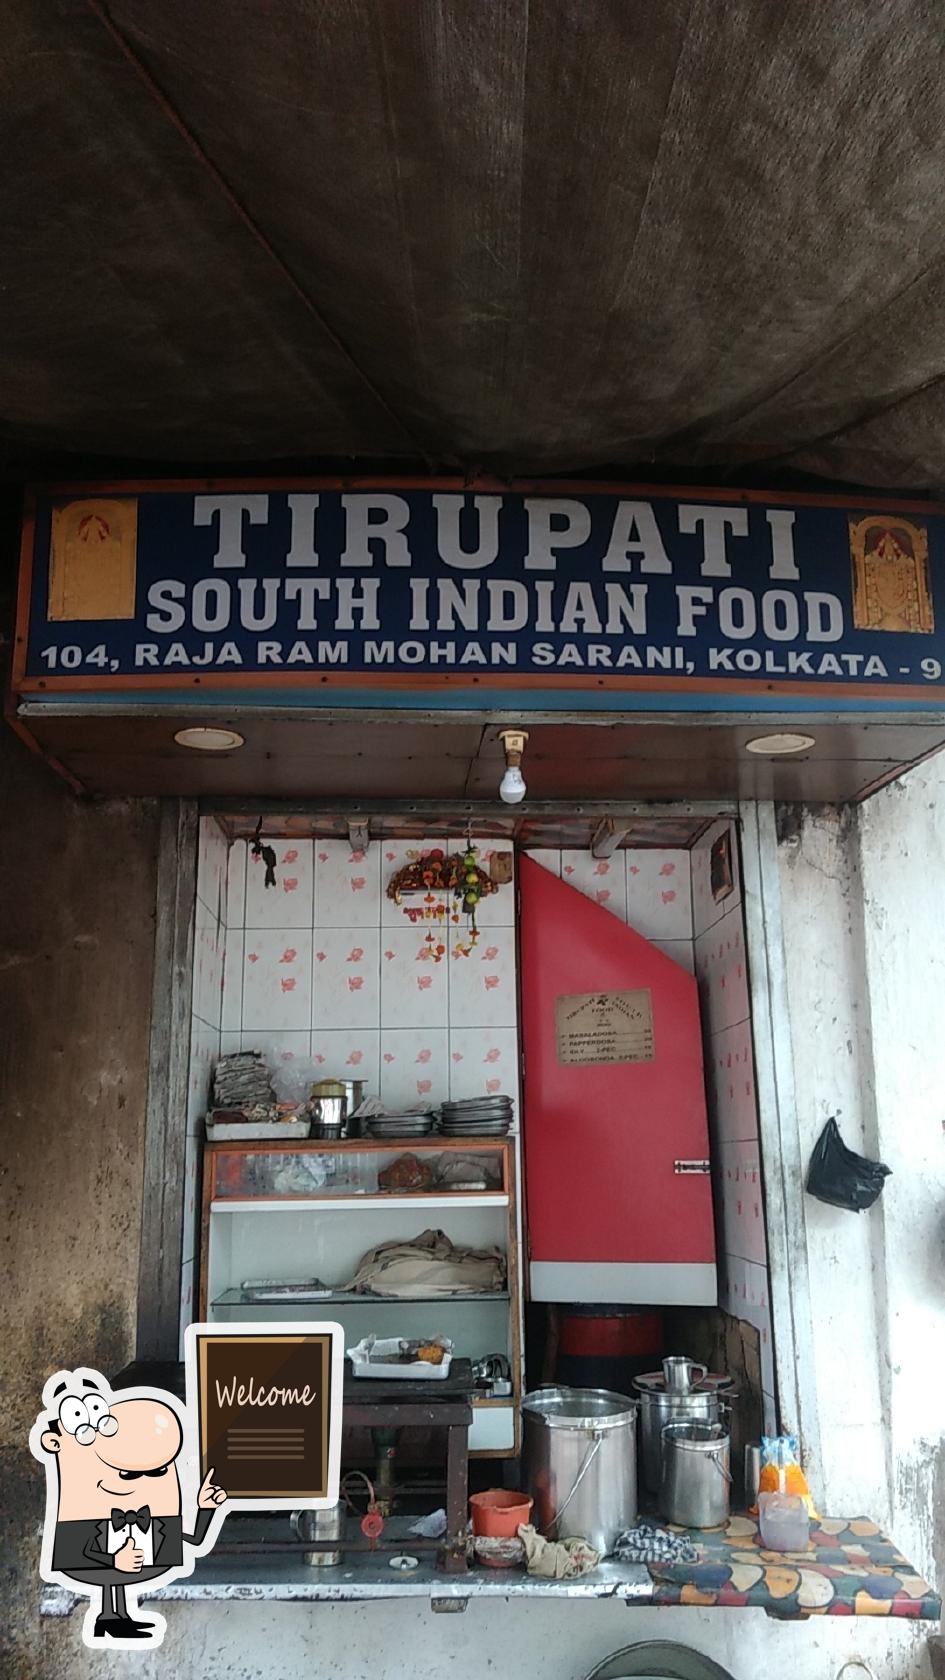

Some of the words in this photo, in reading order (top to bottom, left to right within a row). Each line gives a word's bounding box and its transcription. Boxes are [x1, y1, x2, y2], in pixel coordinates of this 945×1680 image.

[193, 493, 801, 581] TIRUPATI
[146, 577, 381, 634] SOUTH
[409, 577, 649, 636] INDIAN
[675, 584, 845, 643] FOOD
[40, 644, 120, 673] 104,
[134, 642, 243, 668] RAJA
[257, 641, 349, 665] RAM
[363, 640, 518, 666] MOHAN
[531, 642, 696, 675] SARANI,
[708, 648, 889, 679] KOLKATA
[921, 659, 942, 680] 9
